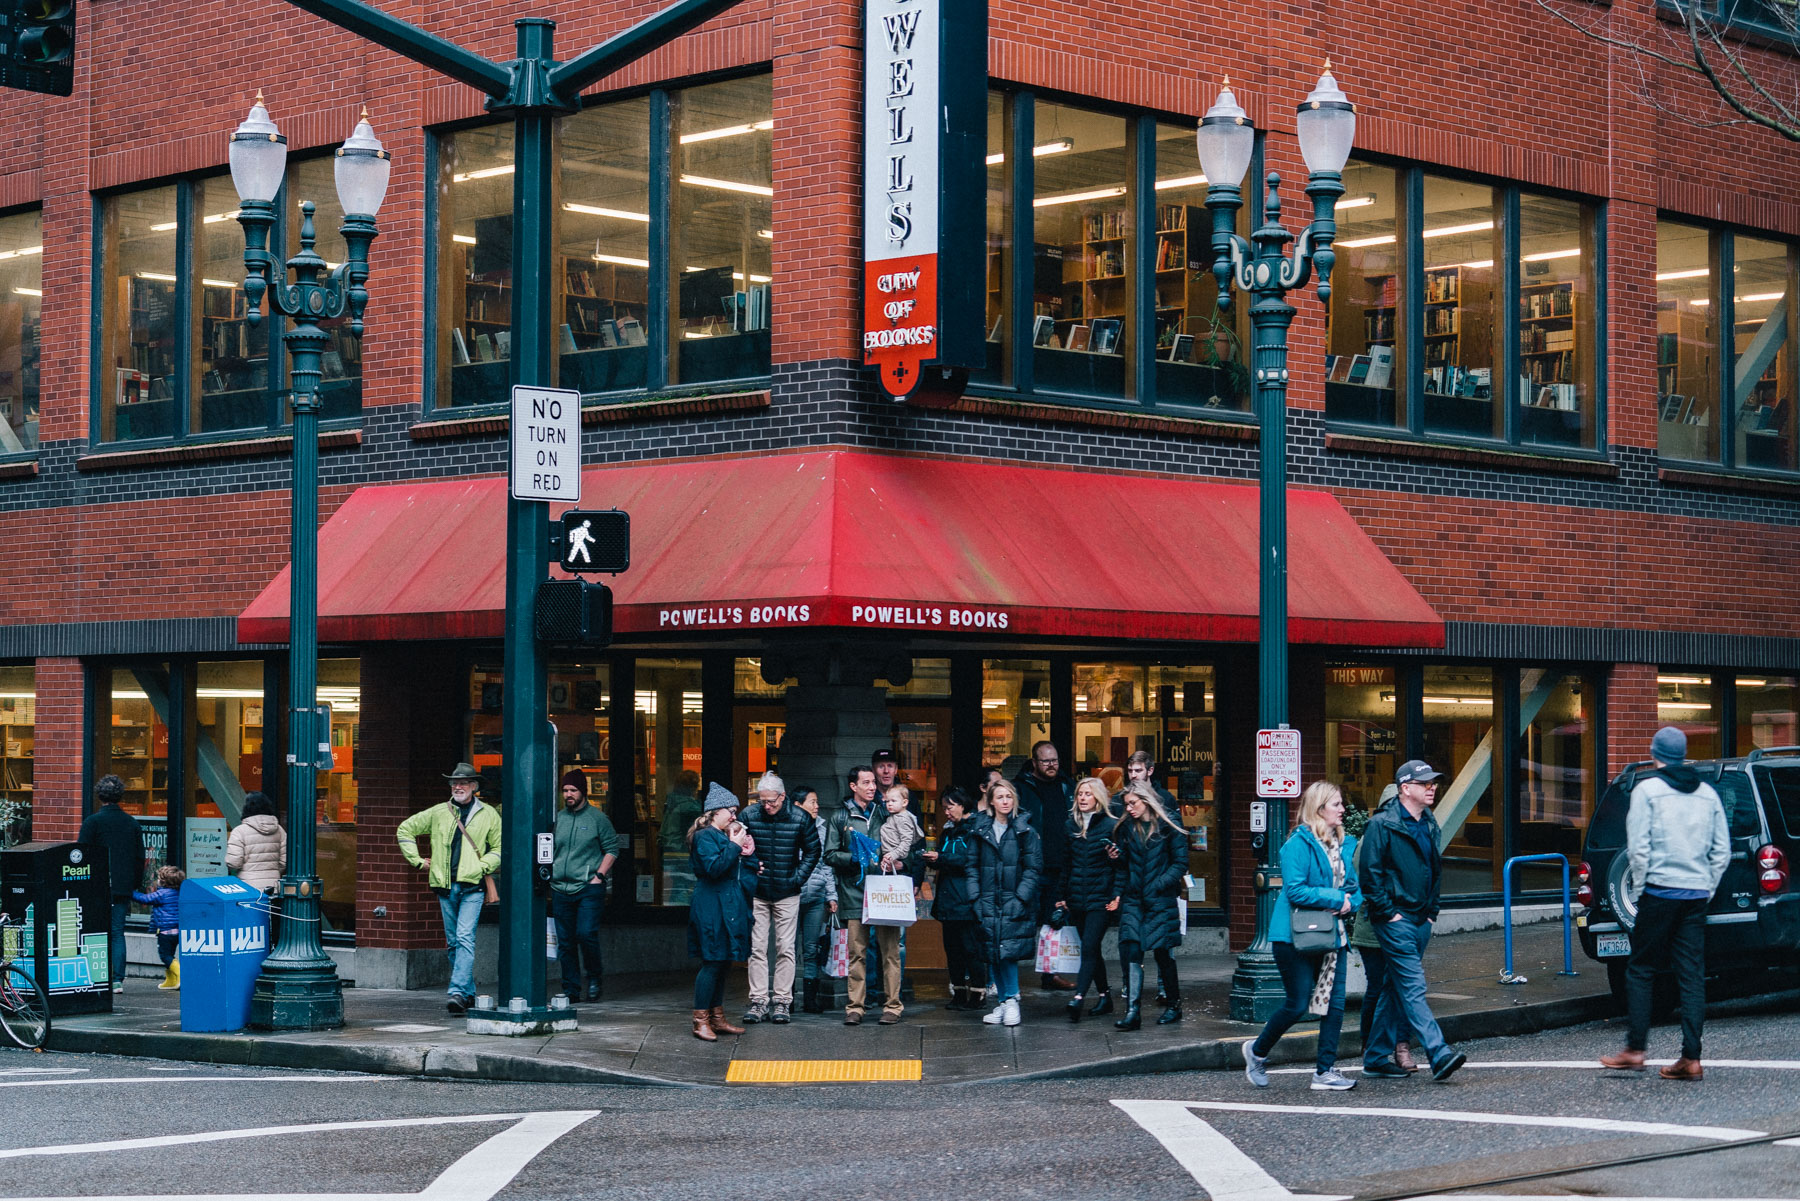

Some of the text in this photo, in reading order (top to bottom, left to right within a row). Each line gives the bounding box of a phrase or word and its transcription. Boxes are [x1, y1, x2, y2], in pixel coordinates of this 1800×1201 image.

[880, 0, 921, 243] WELLS
[877, 271, 921, 293] CITY
[883, 300, 914, 319] OF
[864, 325, 936, 349] BOOKS
[532, 398, 562, 420] NO
[528, 425, 566, 444] TURN
[536, 450, 558, 467] ON
[533, 473, 561, 491] RED
[660, 604, 810, 627] POWELL'S BOOKS
[852, 605, 1009, 629] POWELL'S BOOKS
[1332, 669, 1384, 683] THIS WAY
[1260, 733, 1271, 747] NO
[1271, 733, 1295, 741] PARKING
[1271, 740, 1293, 748] WAITING
[62, 863, 91, 877] Pearl
[871, 892, 912, 904] POWELL'S
